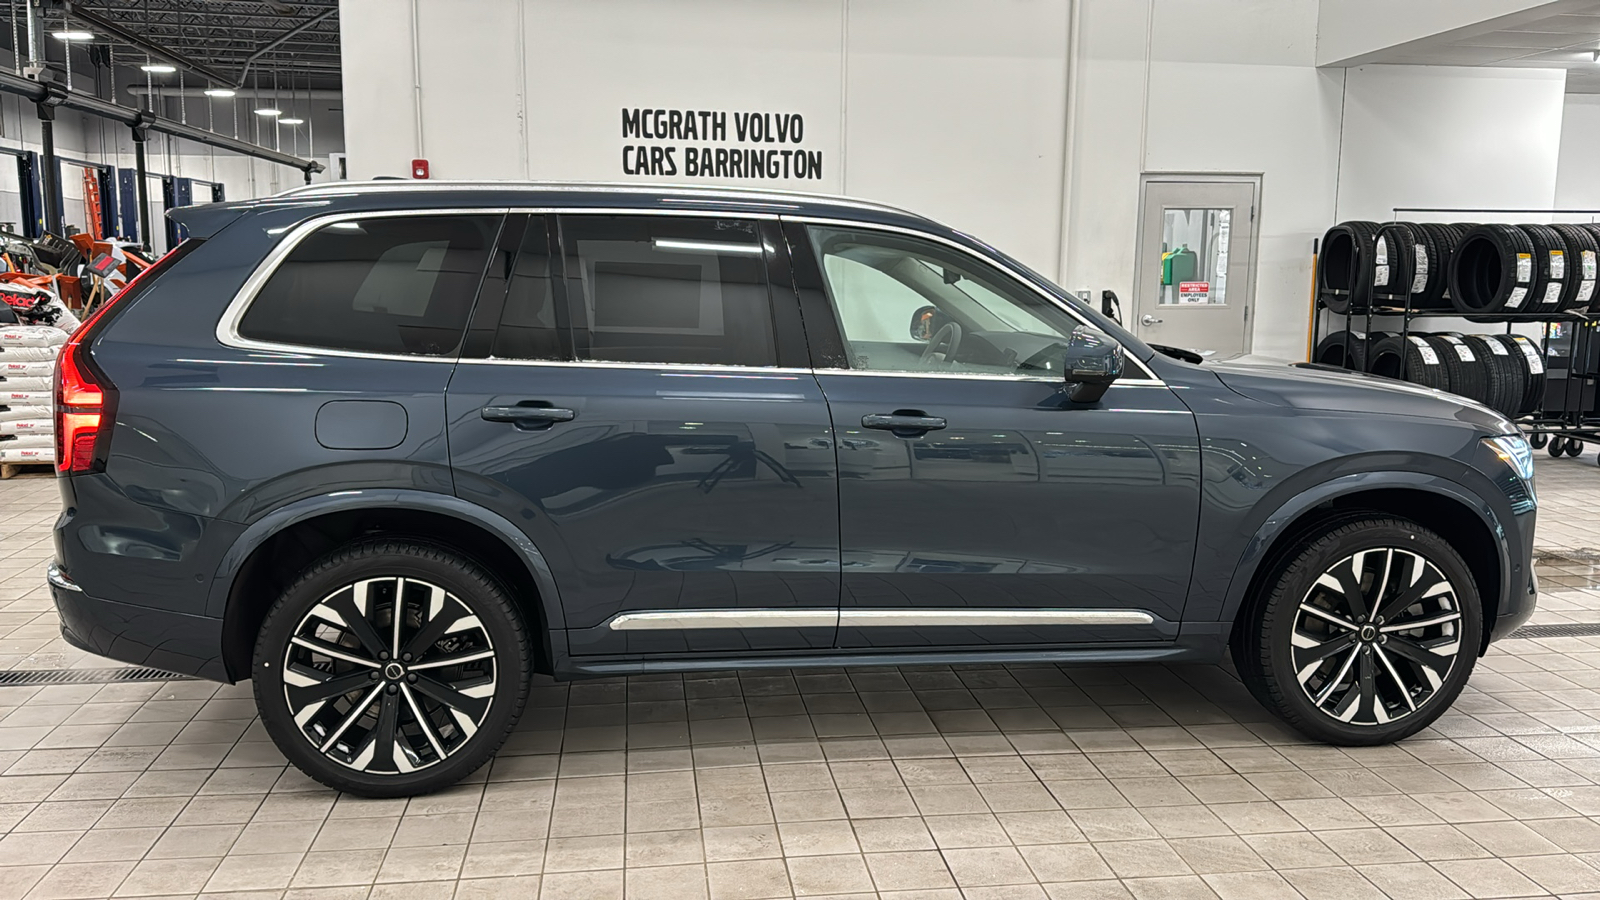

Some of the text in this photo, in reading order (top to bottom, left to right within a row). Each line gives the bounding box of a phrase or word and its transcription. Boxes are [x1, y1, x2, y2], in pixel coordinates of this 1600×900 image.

[622, 108, 804, 143] MCGRATH VOLVO
[622, 145, 823, 180] CARS BARRINGTON
